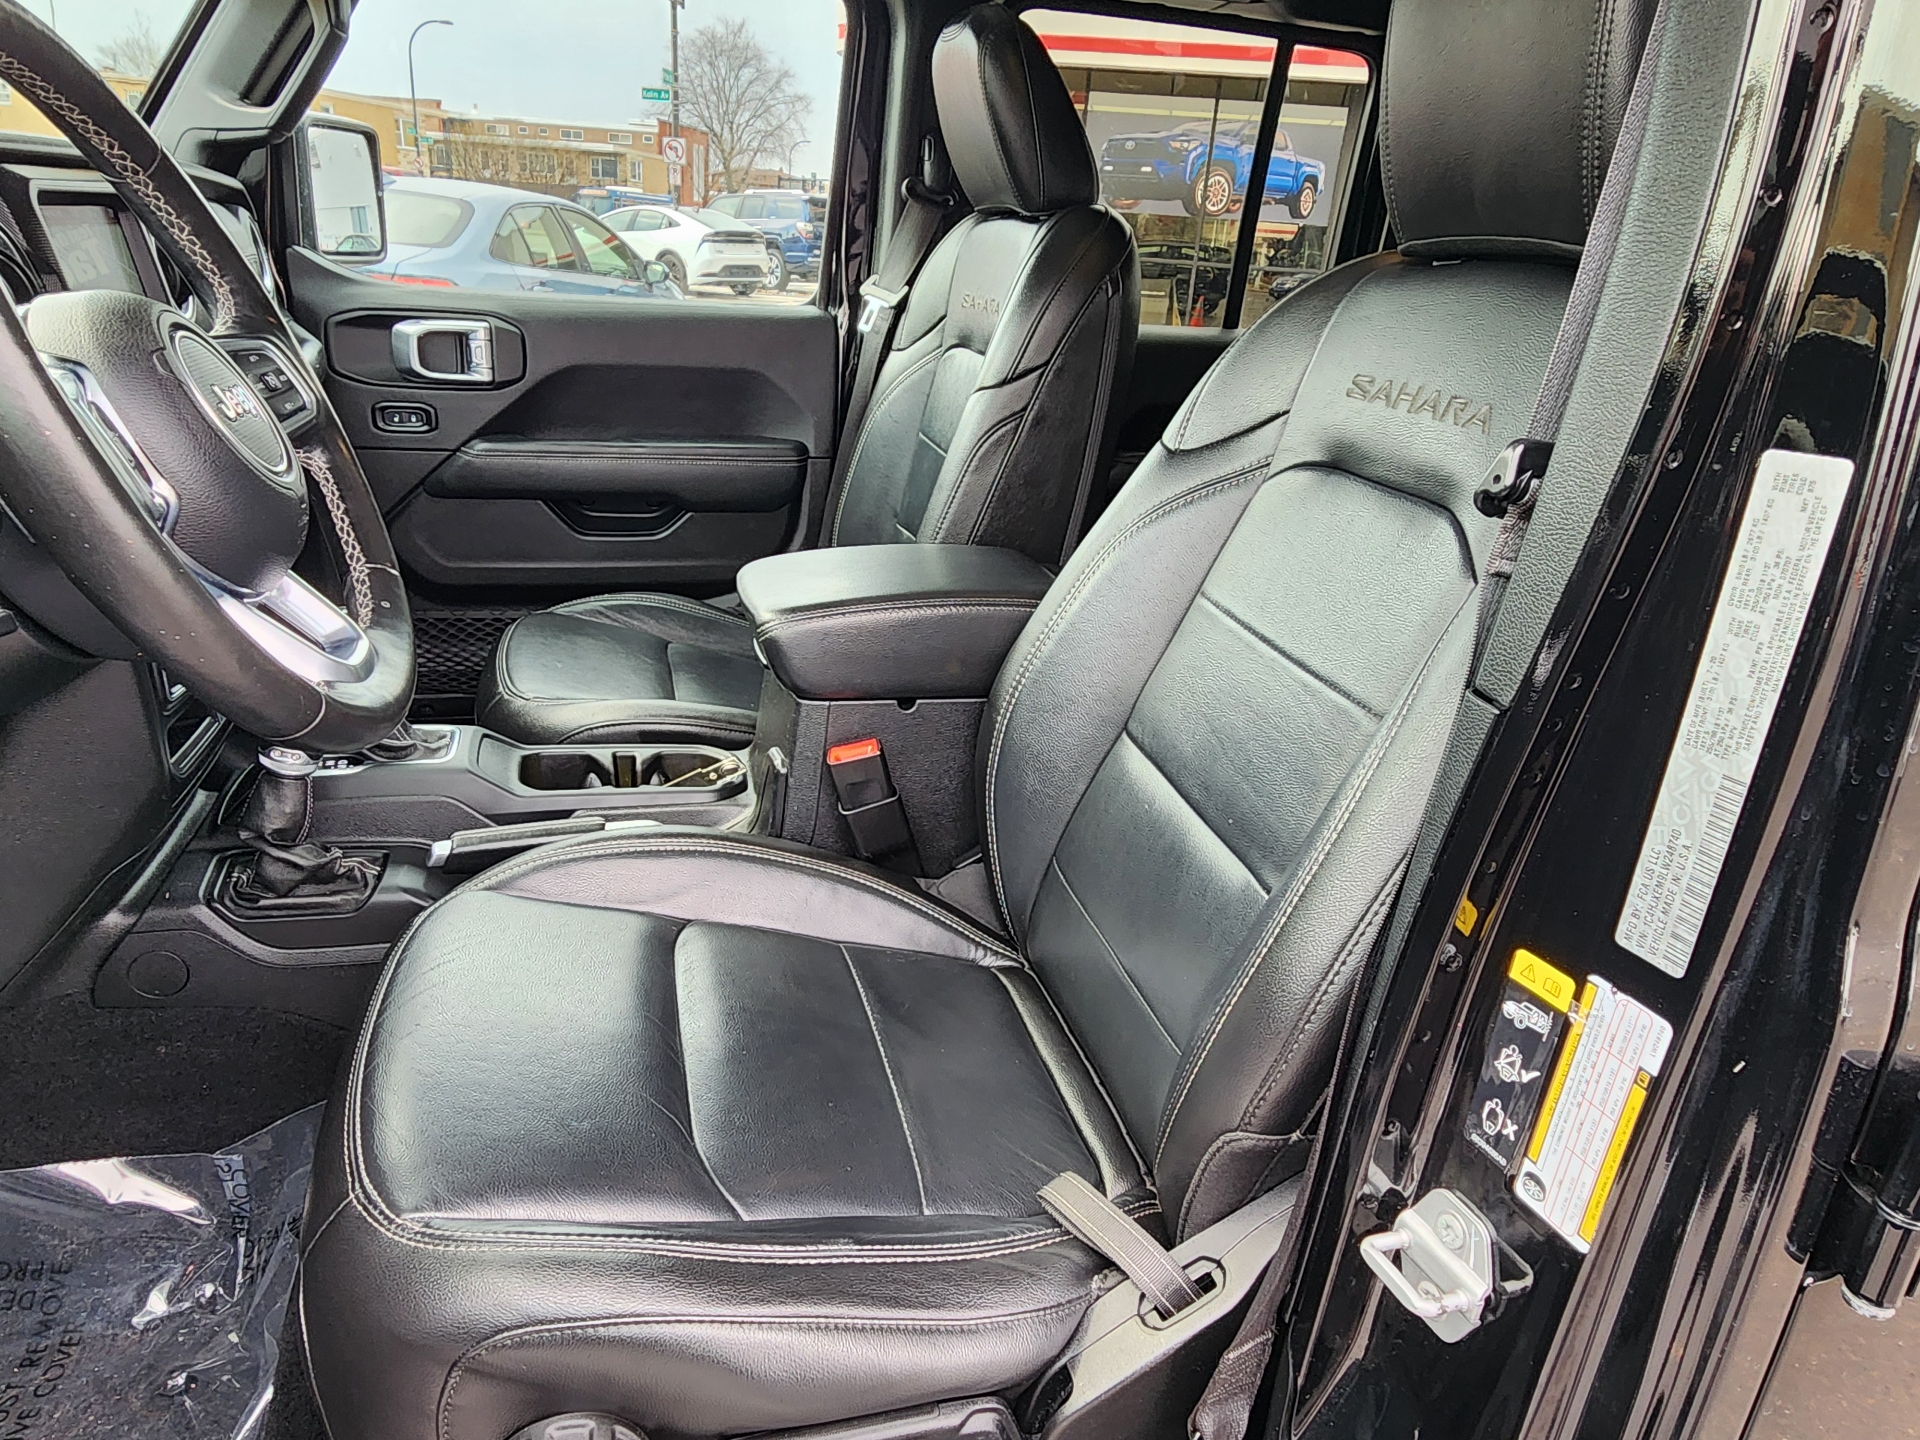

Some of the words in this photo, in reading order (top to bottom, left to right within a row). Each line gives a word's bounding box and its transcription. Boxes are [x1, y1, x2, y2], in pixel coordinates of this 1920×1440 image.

[210, 383, 259, 422] Jeep
[1346, 373, 1492, 436] SAHARA
[1770, 471, 1782, 491] WITH
[1778, 474, 1790, 492] RIMS
[1786, 472, 1799, 493] TIRES
[1795, 476, 1807, 495] COLD
[1806, 495, 1823, 525] VEHICLE
[1819, 504, 1829, 515] OF
[1813, 516, 1826, 535] DATE
[1798, 526, 1813, 551] MOTOR
[1807, 537, 1819, 551] THE
[1787, 553, 1804, 584] FEDERAL
[1803, 553, 1813, 564] ON
[1795, 565, 1809, 590] EFFECT
[1792, 592, 1800, 600] IN
[1758, 605, 1766, 615] AT
[1726, 617, 1737, 635] WITH
[1733, 619, 1744, 637] RIMS
[1741, 619, 1753, 639] TIRES
[1749, 623, 1760, 642] COLD
[1766, 609, 1785, 650] APPLICABLE
[1778, 601, 1797, 643] STANDARDS
[1762, 651, 1772, 664] ALL
[1770, 642, 1793, 693] MANUFACTURE
[1787, 615, 1802, 641] SHOWN
[1758, 664, 1767, 674] TO
[1763, 644, 1783, 686] PREVENTION
[1746, 675, 1764, 712] CONFORMS
[1756, 687, 1769, 709] THEFT
[1737, 712, 1751, 740] VEHICLE
[1751, 710, 1761, 725] AND
[1683, 728, 1694, 746] DATE
[1689, 719, 1697, 728] OF
[1742, 725, 1756, 751] SAFETY
[1712, 748, 1721, 757] AT
[1732, 740, 1742, 756] THIS
[1647, 846, 1661, 865] LLC
[1674, 839, 1692, 871] U.S.A.
[1642, 865, 1655, 881] US
[1669, 870, 1682, 887] IN:
[1636, 880, 1650, 901] FCA
[1630, 901, 1643, 920] BY:
[1660, 887, 1677, 917] MADE
[1623, 919, 1637, 943] MFD
[1635, 928, 1649, 950] VIN:
[1647, 916, 1667, 957] VEHICLE
[20, 1261, 73, 1368] REMOVE
[34, 1321, 85, 1398] COVER
